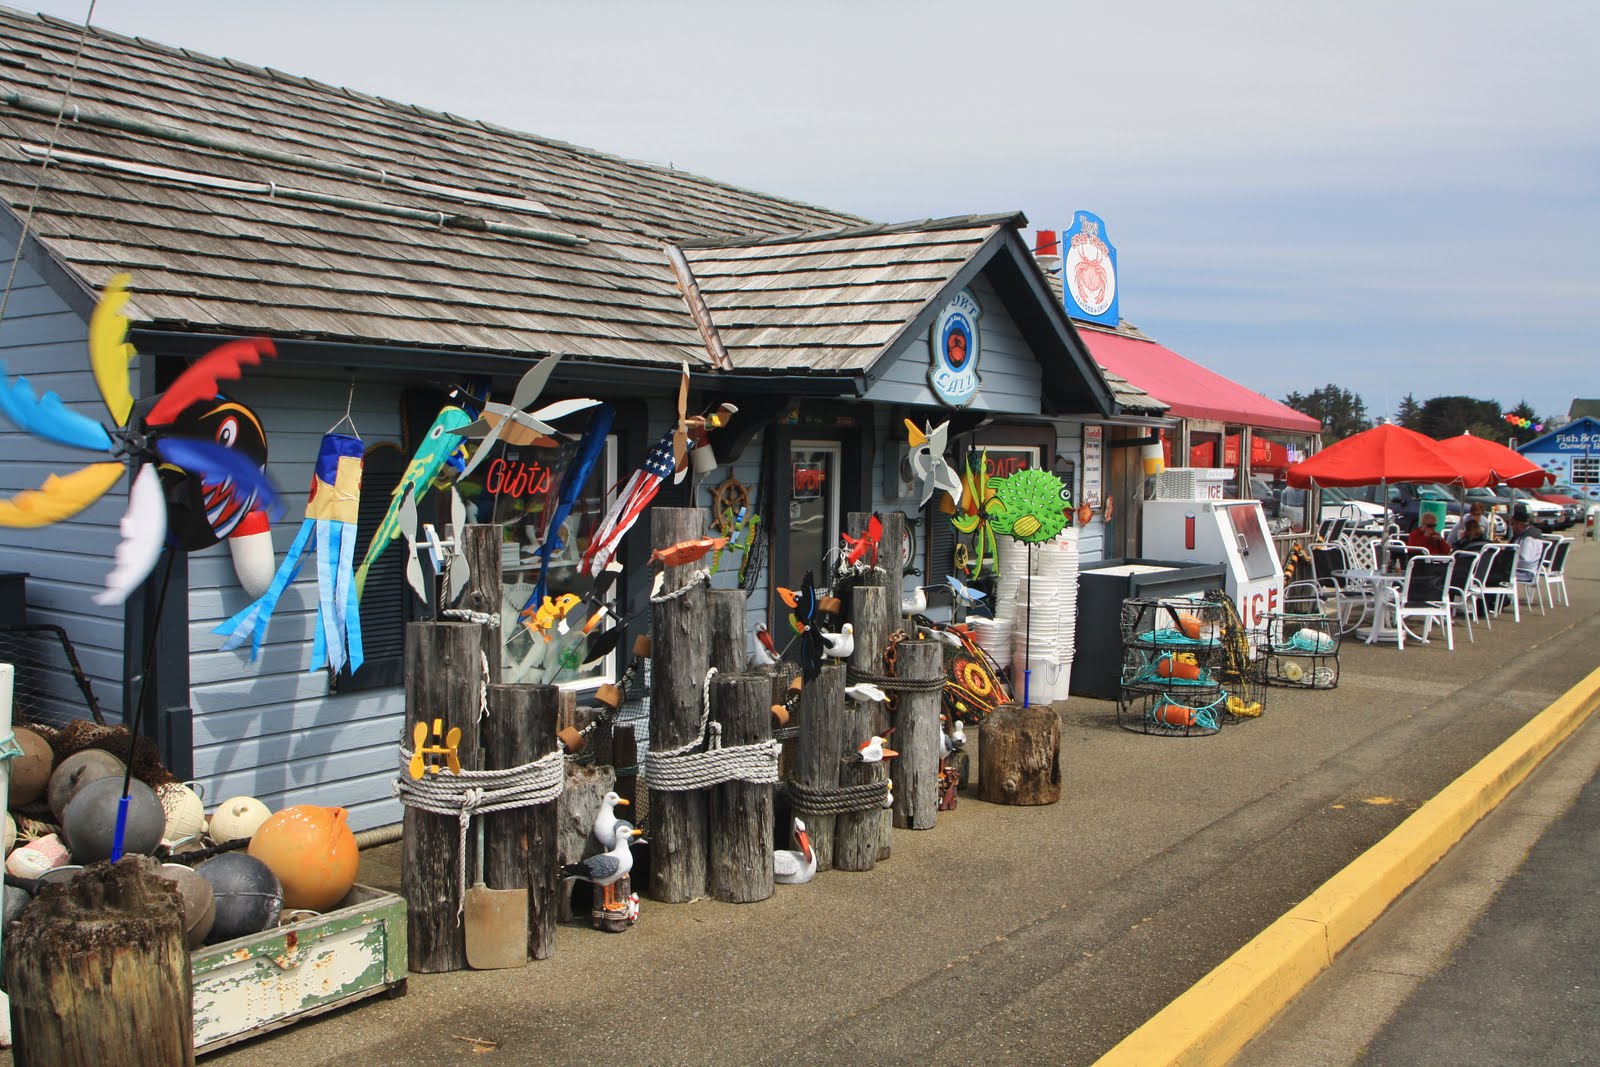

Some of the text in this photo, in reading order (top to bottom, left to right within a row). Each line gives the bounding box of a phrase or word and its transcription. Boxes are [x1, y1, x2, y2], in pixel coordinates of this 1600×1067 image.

[1072, 232, 1109, 258] CRAB SHACK
[942, 294, 978, 316] ORT
[936, 373, 974, 393] CALL
[1556, 433, 1579, 443] Fish
[1580, 433, 1590, 443] &
[1559, 442, 1592, 450] Chowder
[487, 458, 550, 498] Gifts
[1208, 484, 1222, 499] ICE
[1243, 588, 1278, 630] ICE
